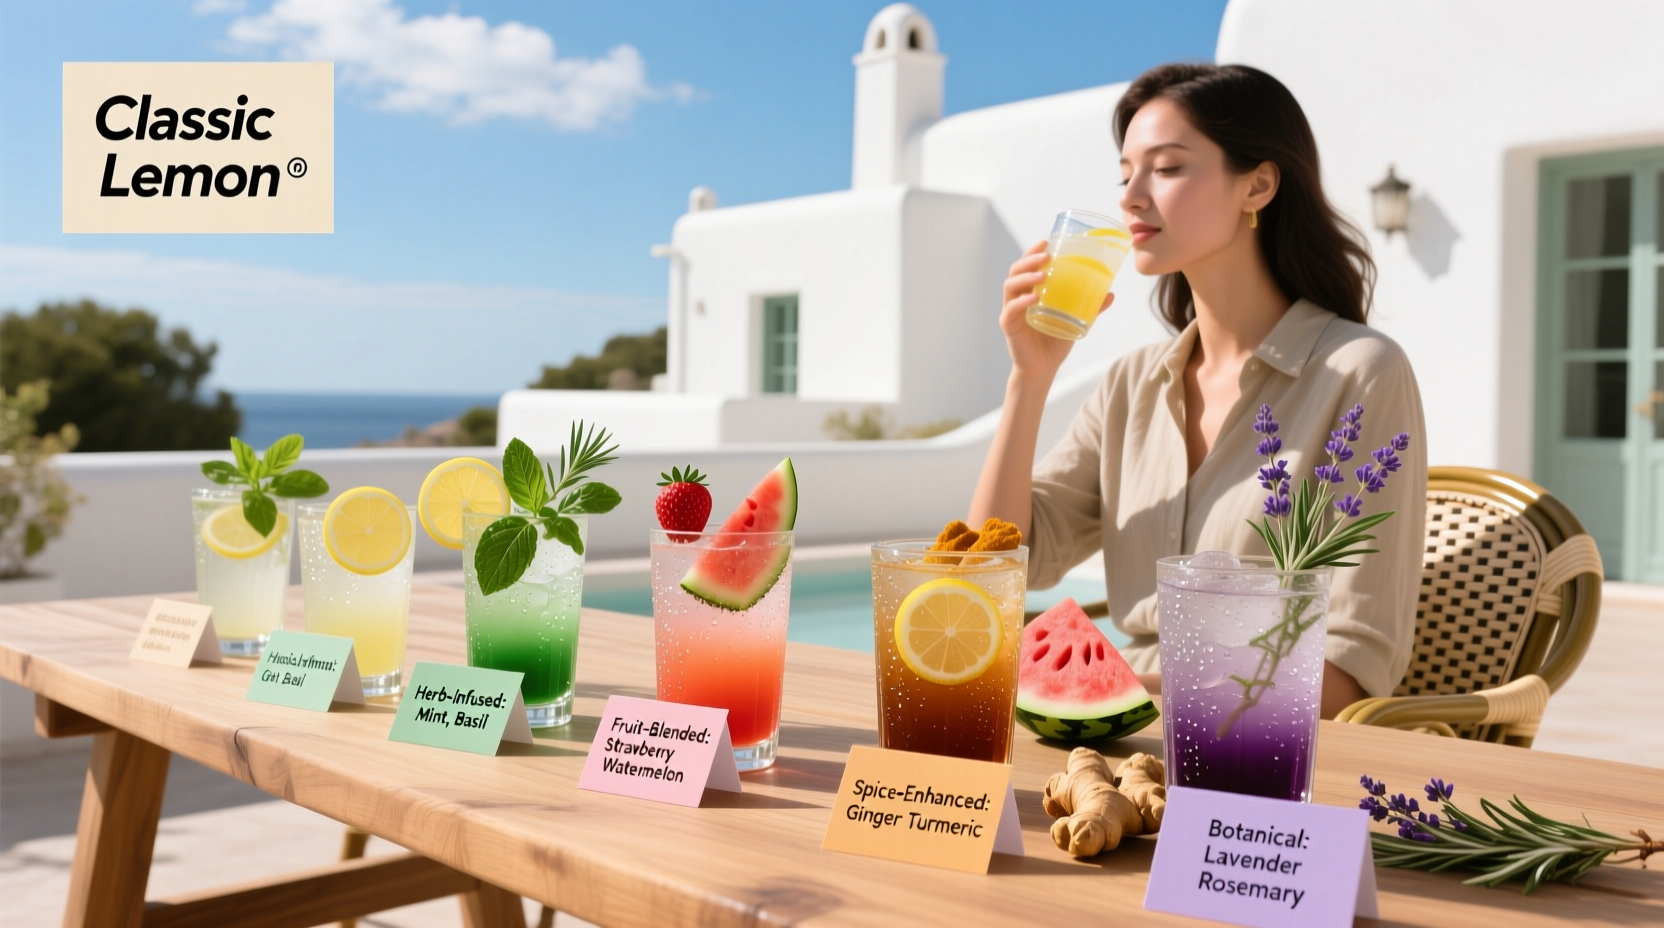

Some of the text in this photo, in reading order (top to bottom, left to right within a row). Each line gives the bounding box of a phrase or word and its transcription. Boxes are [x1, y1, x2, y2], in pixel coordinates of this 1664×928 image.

[414, 685, 507, 709] Herb-Infused:
[414, 706, 490, 730] Mint, Basil
[611, 717, 711, 745] Fruit-Blended:
[602, 756, 684, 783] Watermelon
[852, 779, 991, 812] Spice-Enhanced:
[846, 804, 984, 838] Ginger Turmeric
[1208, 819, 1310, 850] Botanical:
[1203, 845, 1303, 875] Lavender
[1198, 871, 1305, 910] Rosemary
